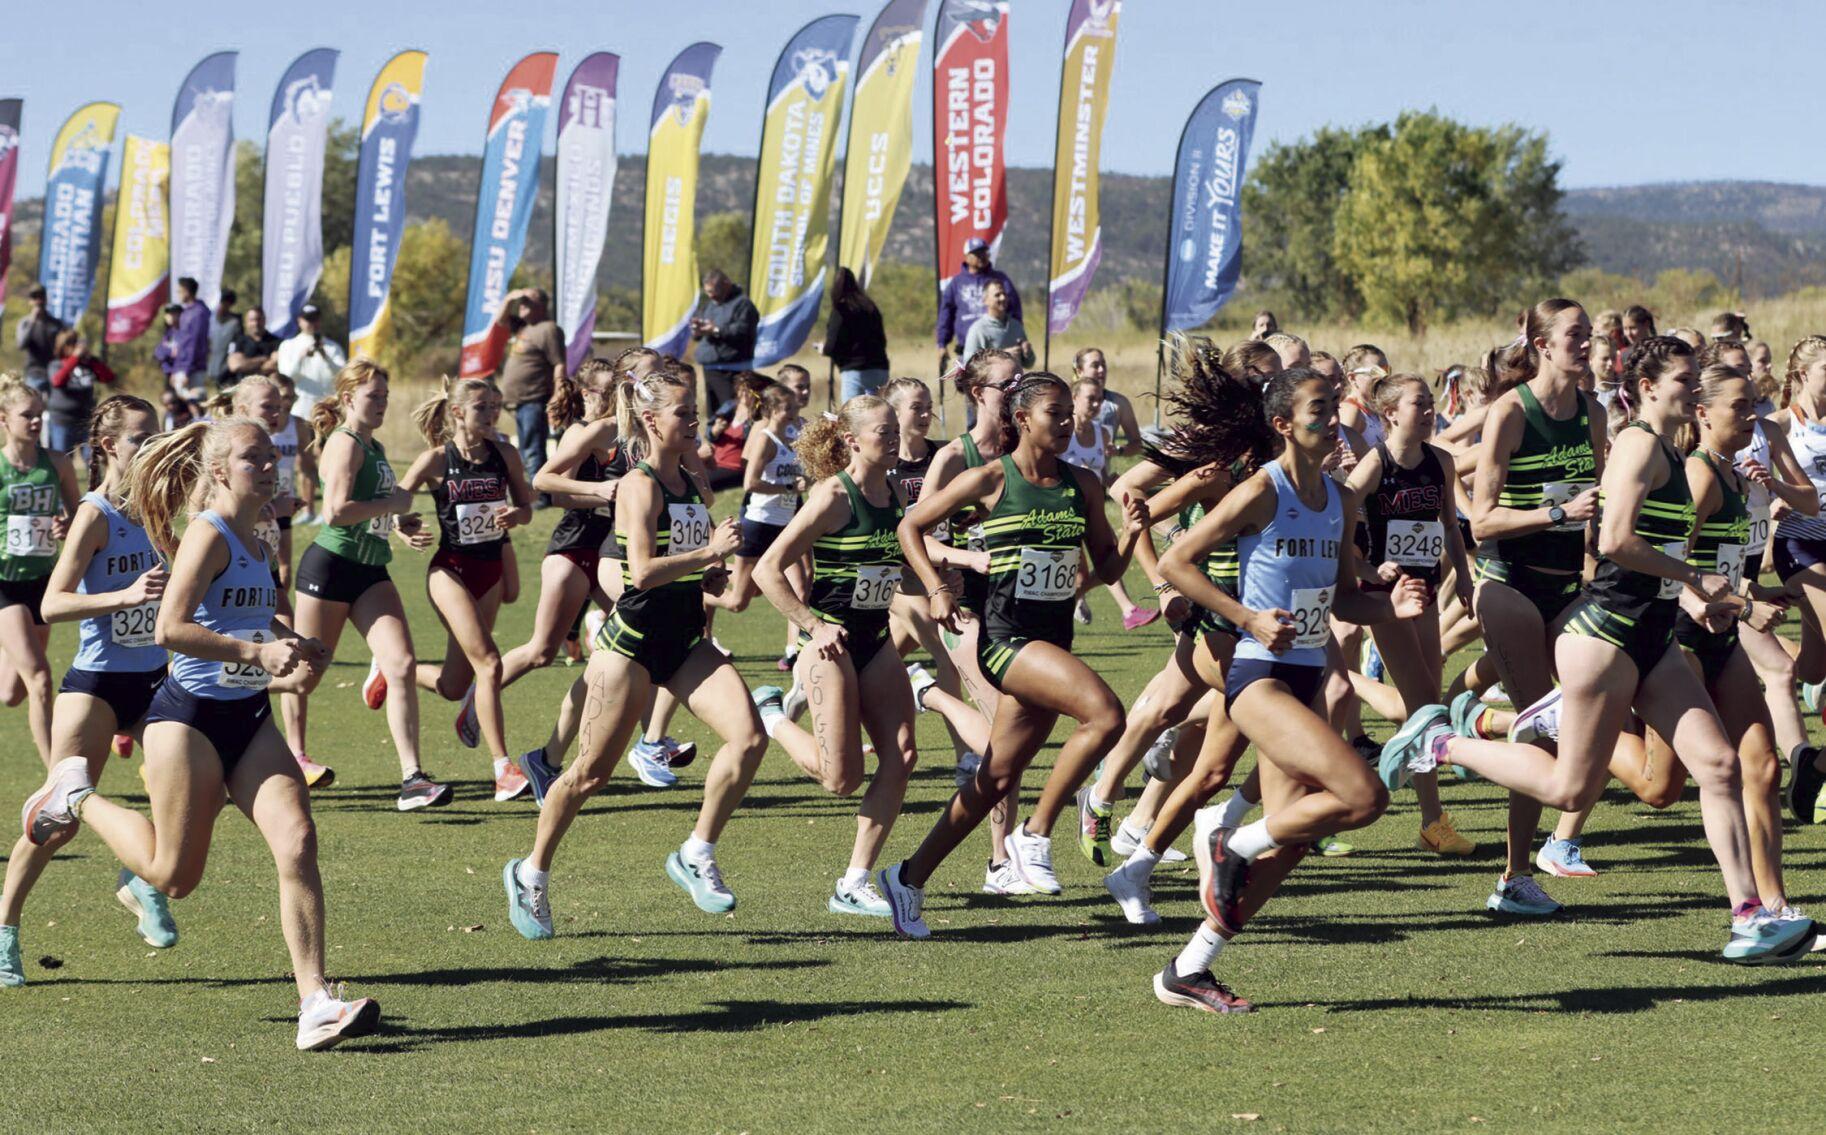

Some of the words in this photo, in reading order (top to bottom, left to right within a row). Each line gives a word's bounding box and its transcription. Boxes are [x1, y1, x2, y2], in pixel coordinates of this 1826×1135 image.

[776, 100, 807, 203] DAKOTA
[804, 111, 824, 174] MINES
[948, 67, 969, 225] WESTERN
[973, 58, 994, 230] COLORADO
[1066, 45, 1098, 263] WESTMINSTER
[1205, 127, 1237, 209] YOURS
[373, 137, 396, 223] LEWIS
[491, 119, 528, 240] DENVER
[866, 132, 889, 221] UCCS
[1184, 162, 1200, 231] DIVISION
[662, 177, 682, 264] REGIS
[1213, 210, 1227, 231] IT
[368, 228, 388, 298] FORT
[482, 246, 506, 314] MSU
[768, 211, 793, 298] SOUTH
[1205, 233, 1224, 290] MAKE
[8, 483, 55, 514] BH
[447, 478, 504, 502] MES
[1021, 506, 1077, 529] Adams
[1378, 485, 1441, 515] MES
[461, 514, 500, 535] 324
[673, 520, 710, 545] 3164
[1276, 538, 1315, 558] FORT
[1388, 534, 1443, 557] 3248
[107, 551, 145, 576] FORT
[1021, 563, 1077, 589] 3168
[115, 607, 160, 637] 328
[221, 588, 262, 607] FORT
